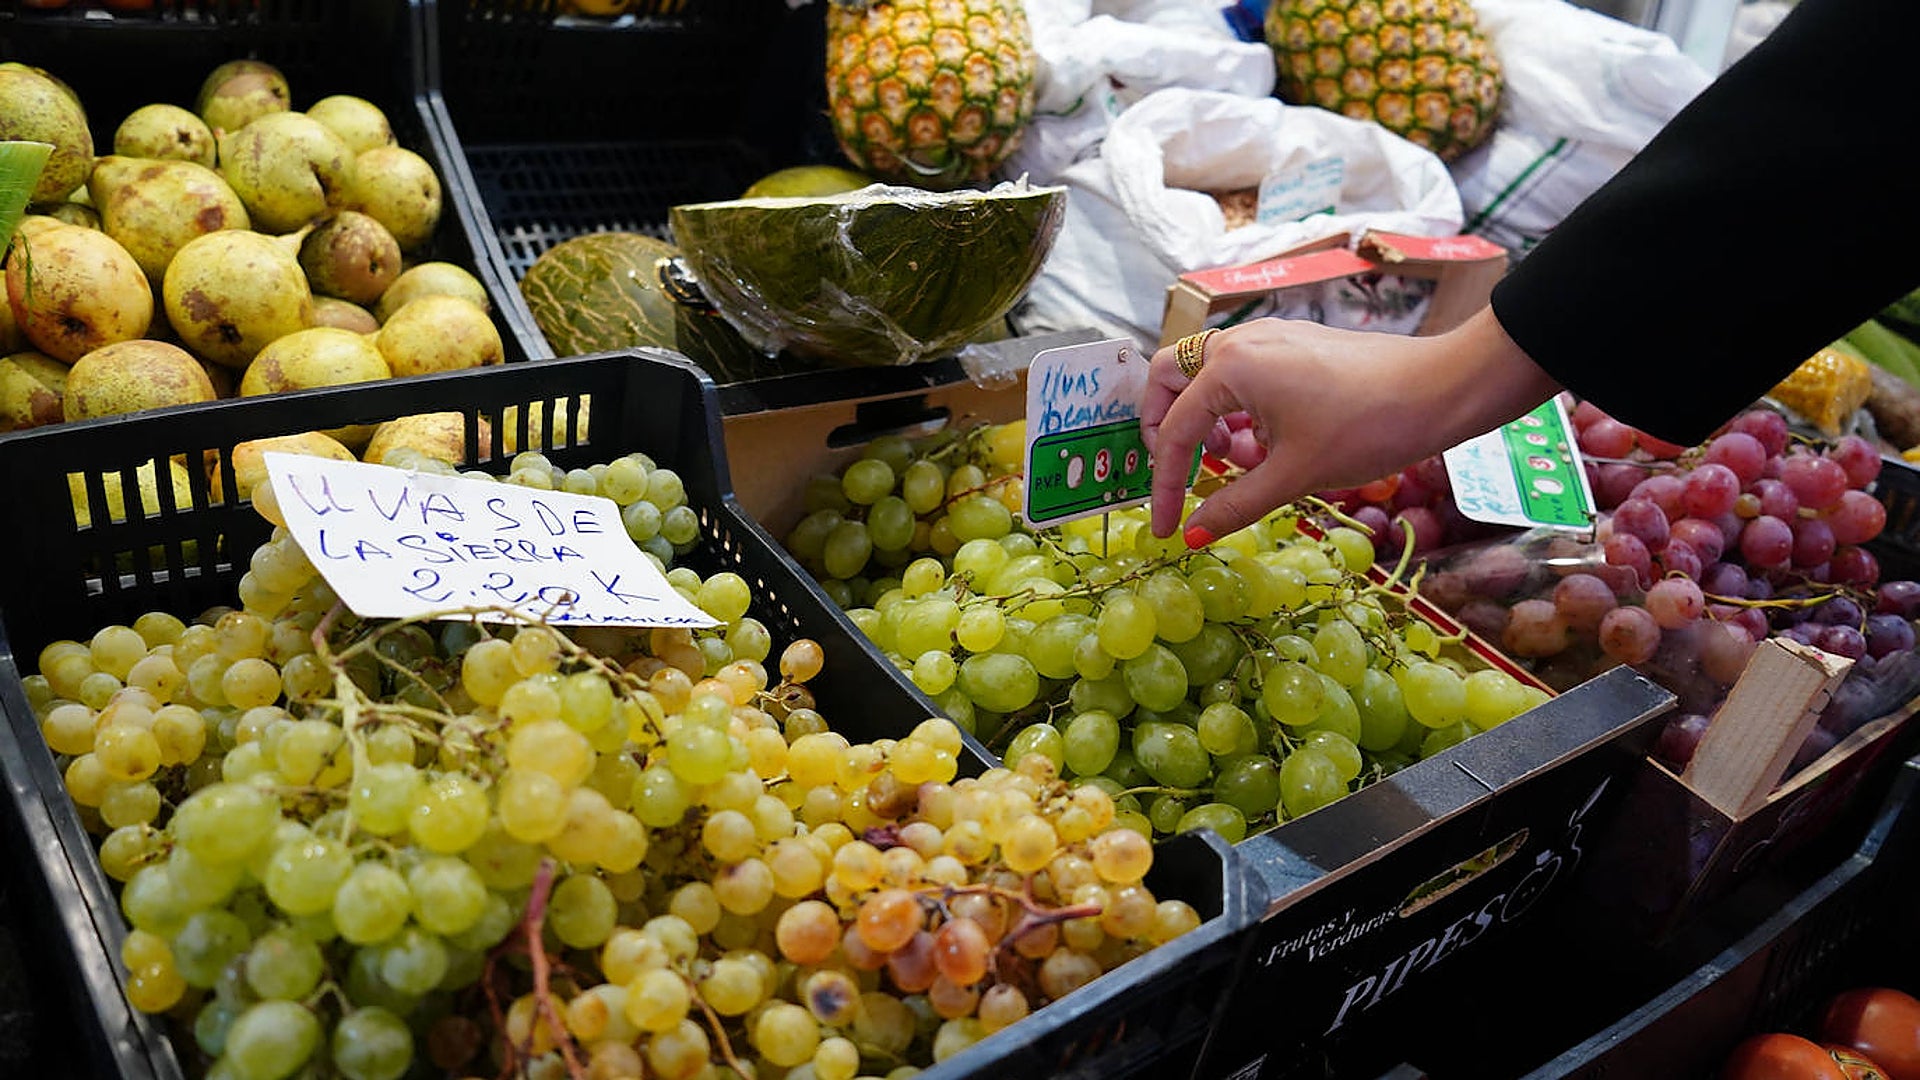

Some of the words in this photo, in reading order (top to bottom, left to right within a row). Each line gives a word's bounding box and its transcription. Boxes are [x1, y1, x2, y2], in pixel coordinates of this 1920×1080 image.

[288, 473, 520, 532] UVAS
[532, 500, 603, 536] DE
[320, 529, 393, 562] LA
[590, 570, 661, 605] K
[1264, 918, 1338, 968] Frutas
[1338, 908, 1357, 932] y
[1307, 906, 1397, 963] Verduras
